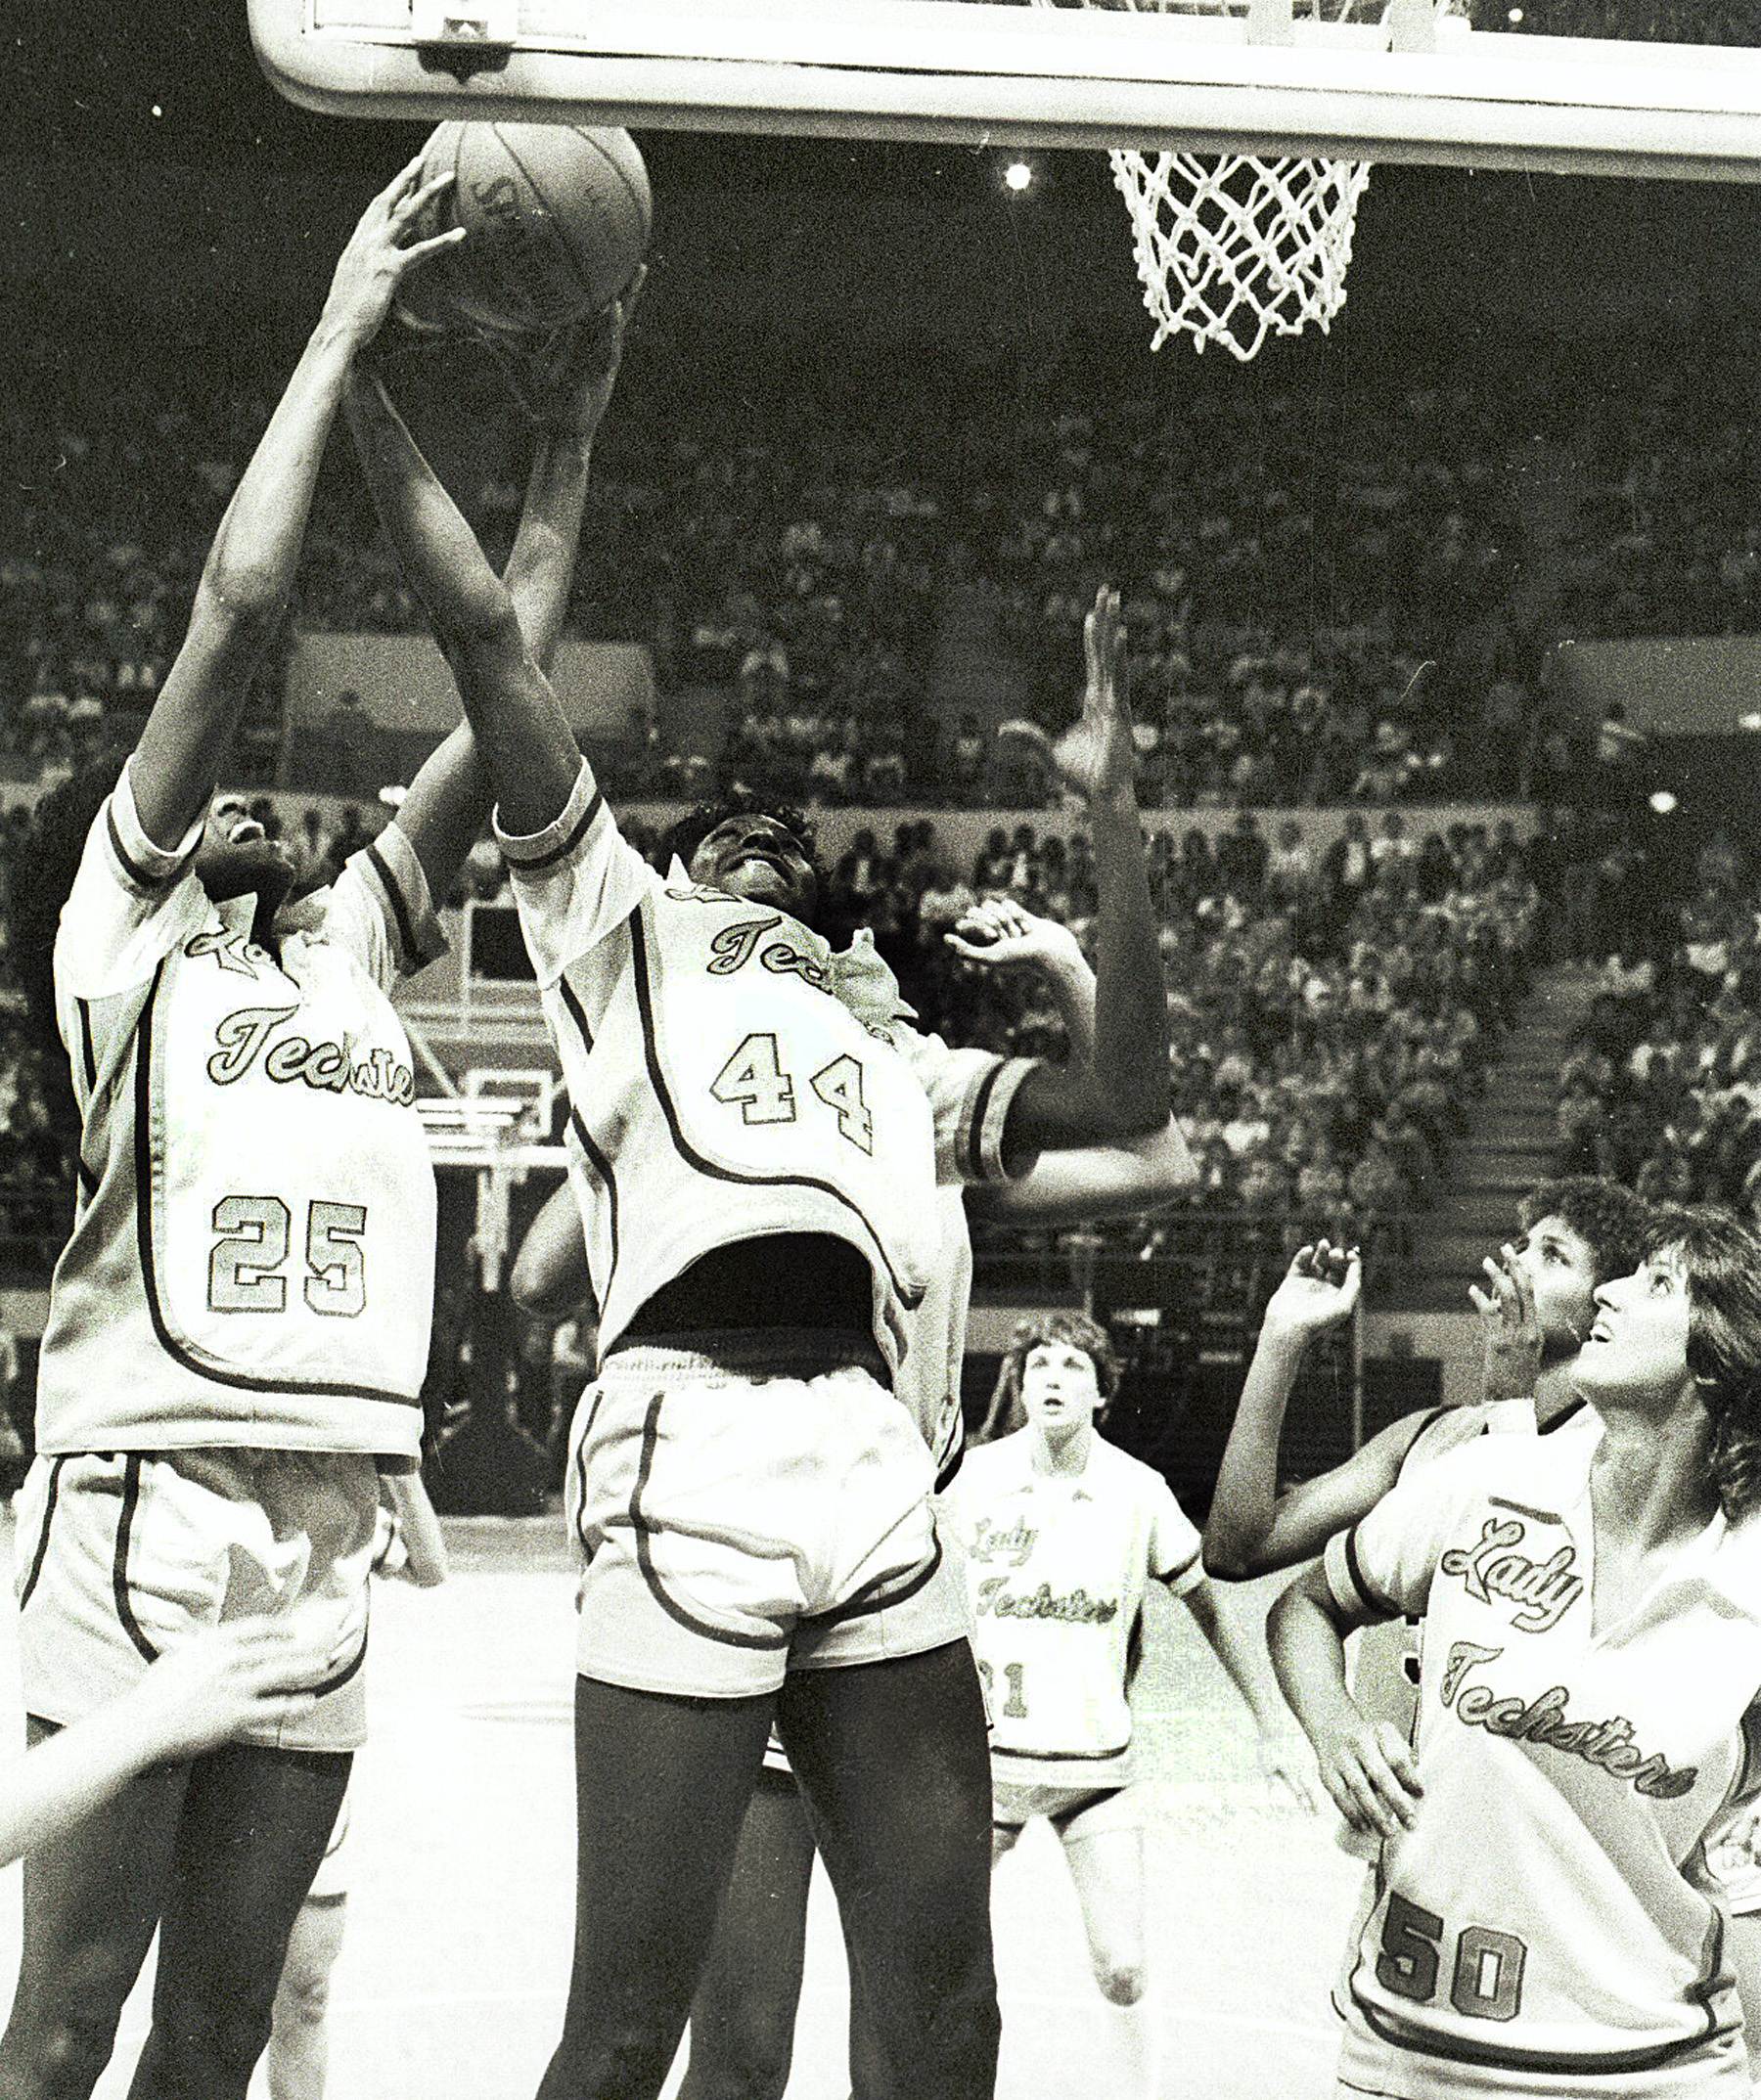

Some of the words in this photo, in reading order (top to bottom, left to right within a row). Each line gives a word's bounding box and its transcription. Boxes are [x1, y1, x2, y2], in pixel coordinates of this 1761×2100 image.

[709, 1032, 874, 1157] 44
[206, 1195, 367, 1318] 25
[1441, 1518, 1584, 1633] Lady
[1439, 1640, 1697, 1799] Techsters
[1375, 1891, 1528, 2023] 50
